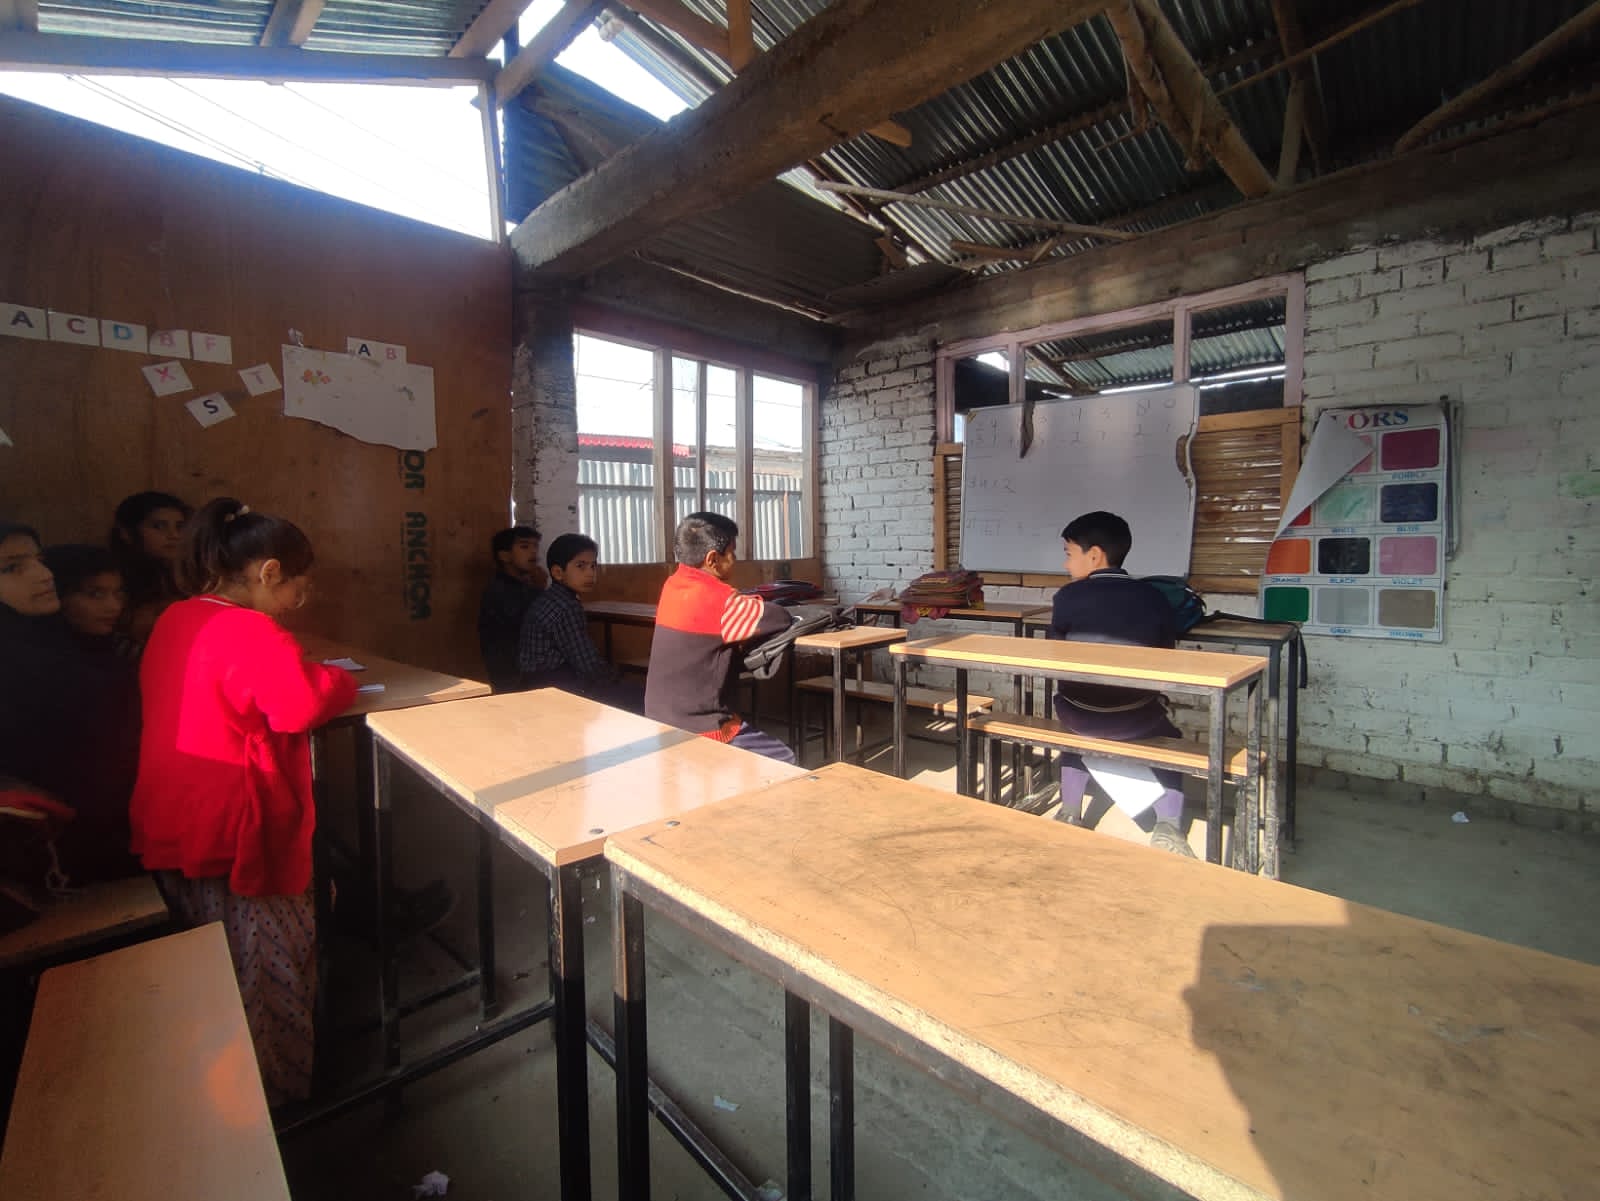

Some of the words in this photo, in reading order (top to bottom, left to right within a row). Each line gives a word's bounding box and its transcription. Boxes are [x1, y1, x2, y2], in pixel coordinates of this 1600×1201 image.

[11, 310, 34, 329] A
[67, 318, 87, 335] C
[112, 324, 135, 341] D
[204, 335, 217, 352] F
[357, 343, 372, 358] A
[385, 347, 399, 360] B
[154, 367, 177, 383] X
[202, 398, 219, 415] S
[405, 511, 432, 622] ANCHOR
[1391, 578, 1424, 586] VIOLET
